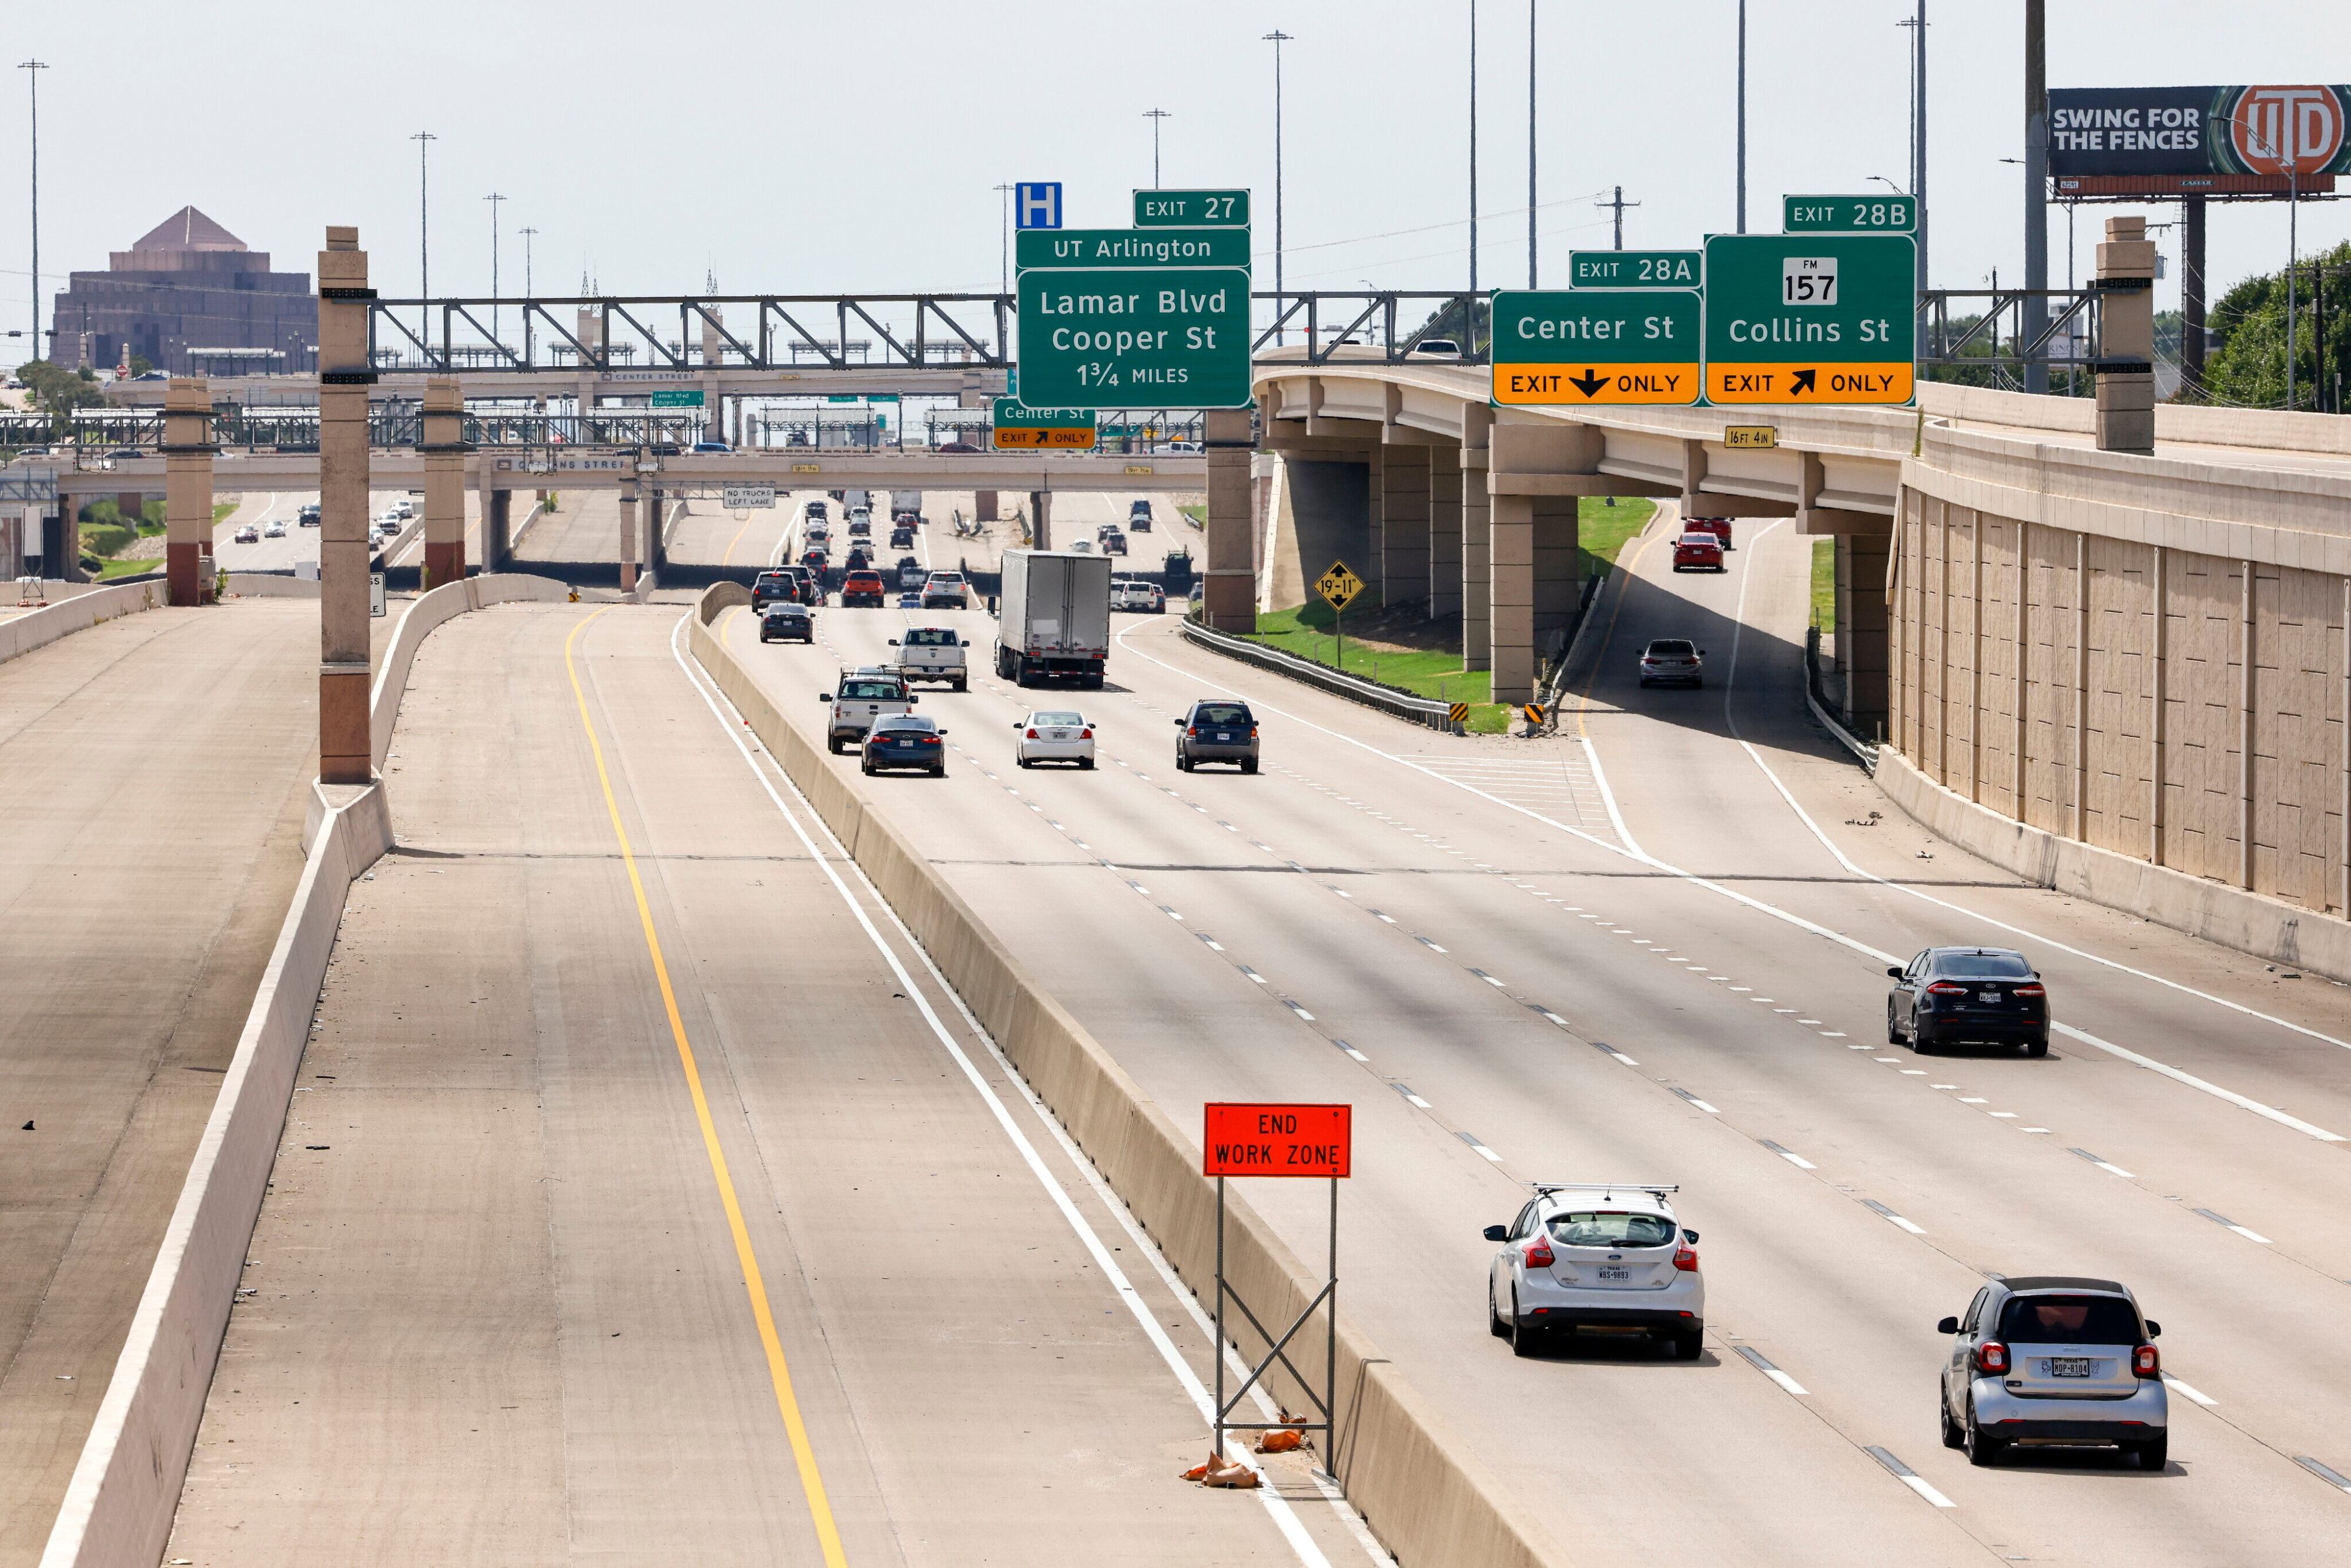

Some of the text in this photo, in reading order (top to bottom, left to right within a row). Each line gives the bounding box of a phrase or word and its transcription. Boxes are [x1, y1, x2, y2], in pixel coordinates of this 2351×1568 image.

[2054, 108, 2199, 128] SWING FOR
[2054, 130, 2199, 150] THE FENCES
[1023, 186, 1054, 226] H
[1147, 197, 1235, 219] EXIT 27
[1794, 204, 1906, 225] EXIT 28B
[1055, 239, 1211, 262] UT Arlington
[1579, 259, 1692, 280] EXIT 28A
[1803, 260, 1817, 269] FM
[1786, 276, 1835, 300] 157
[1041, 289, 1226, 314] Lamar Blvd
[1518, 316, 1674, 339] Center St
[1730, 318, 1890, 342] Collins St
[1053, 327, 1216, 356] Cooper St
[1133, 368, 1188, 383] MILES
[1511, 376, 1680, 392] EXIT ONLY
[1724, 375, 1894, 392] EXIT ONLY
[1005, 407, 1085, 418] Center St
[1002, 433, 1087, 442] EXIT ONLY
[584, 461, 624, 469] STREE
[1259, 1114, 1297, 1134] END
[1215, 1144, 1339, 1165] WORK ZONE
